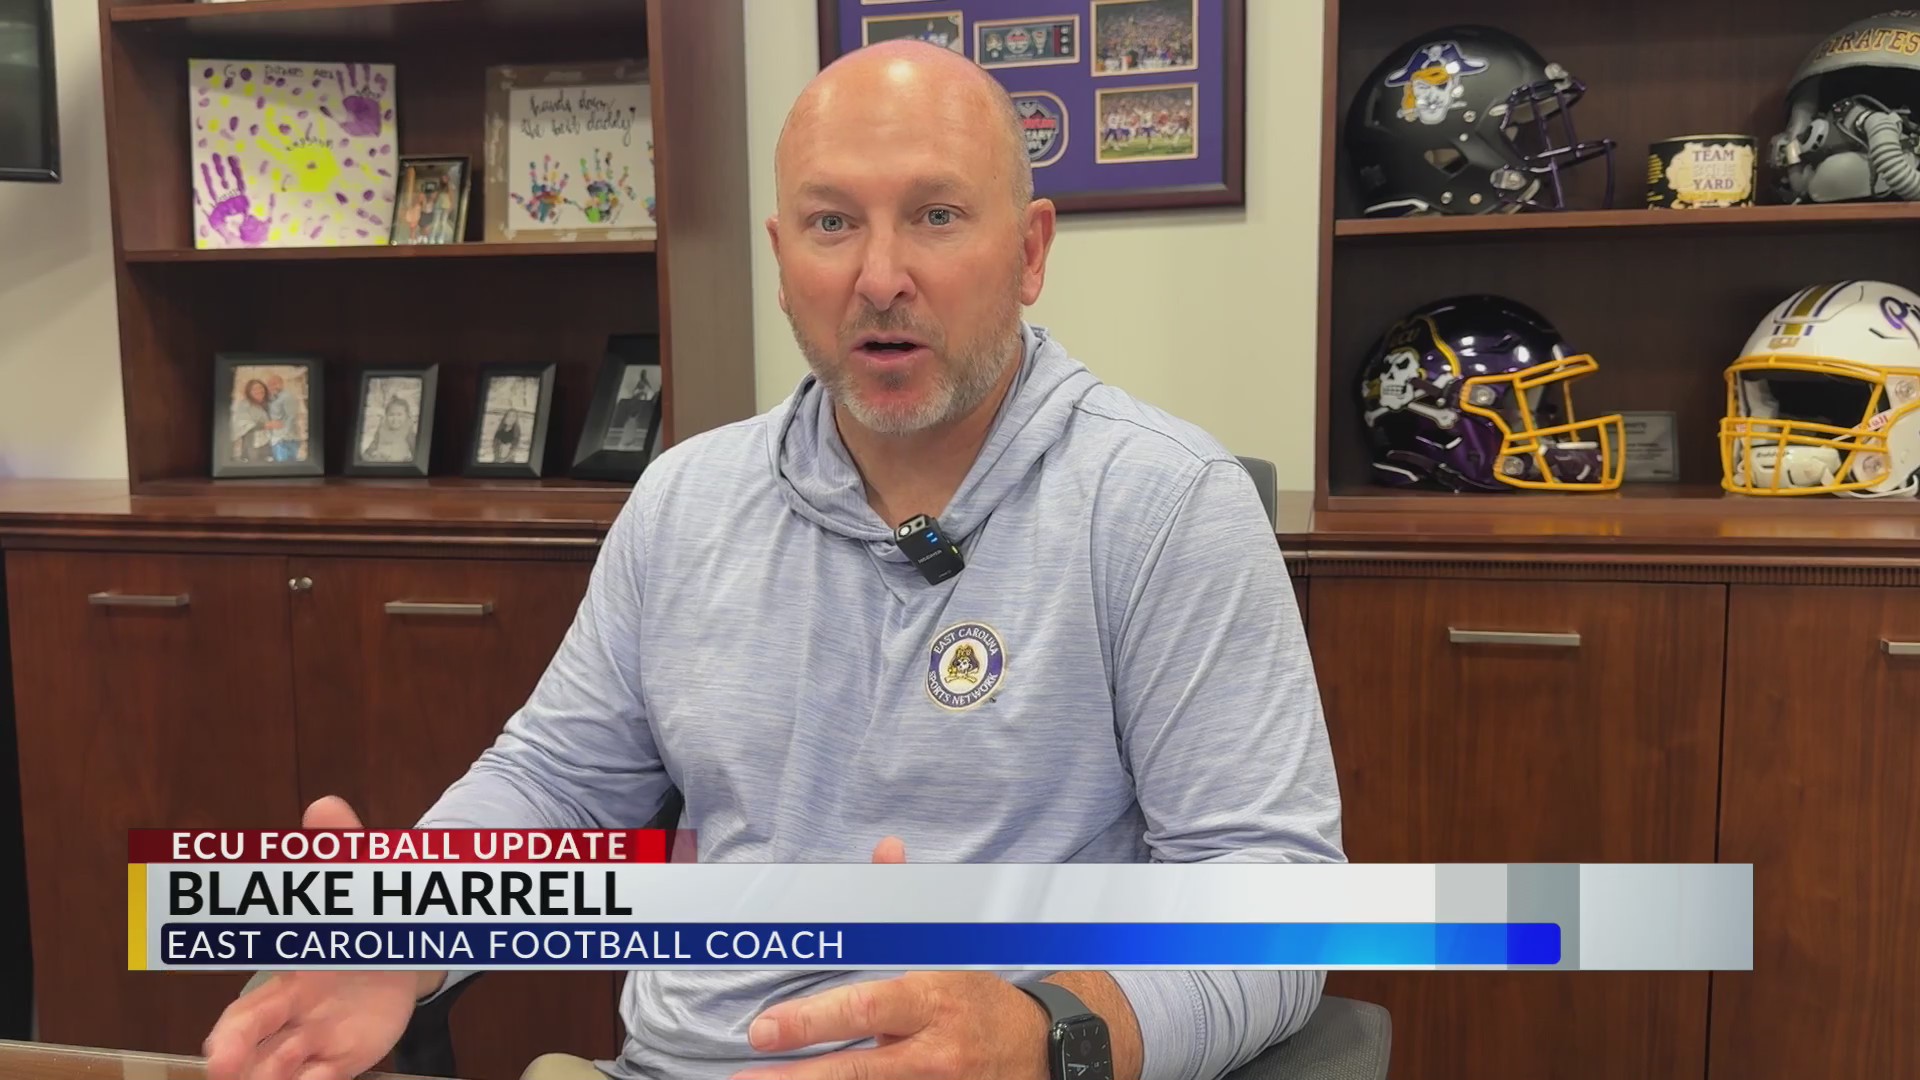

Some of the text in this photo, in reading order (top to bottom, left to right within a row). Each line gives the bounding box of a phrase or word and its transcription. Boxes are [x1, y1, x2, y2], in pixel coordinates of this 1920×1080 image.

[1693, 149, 1735, 162] TEAM
[1692, 178, 1735, 190] YARD
[933, 627, 999, 656] EAST CAROLINA
[929, 670, 999, 706] SPORTS NETWORK
